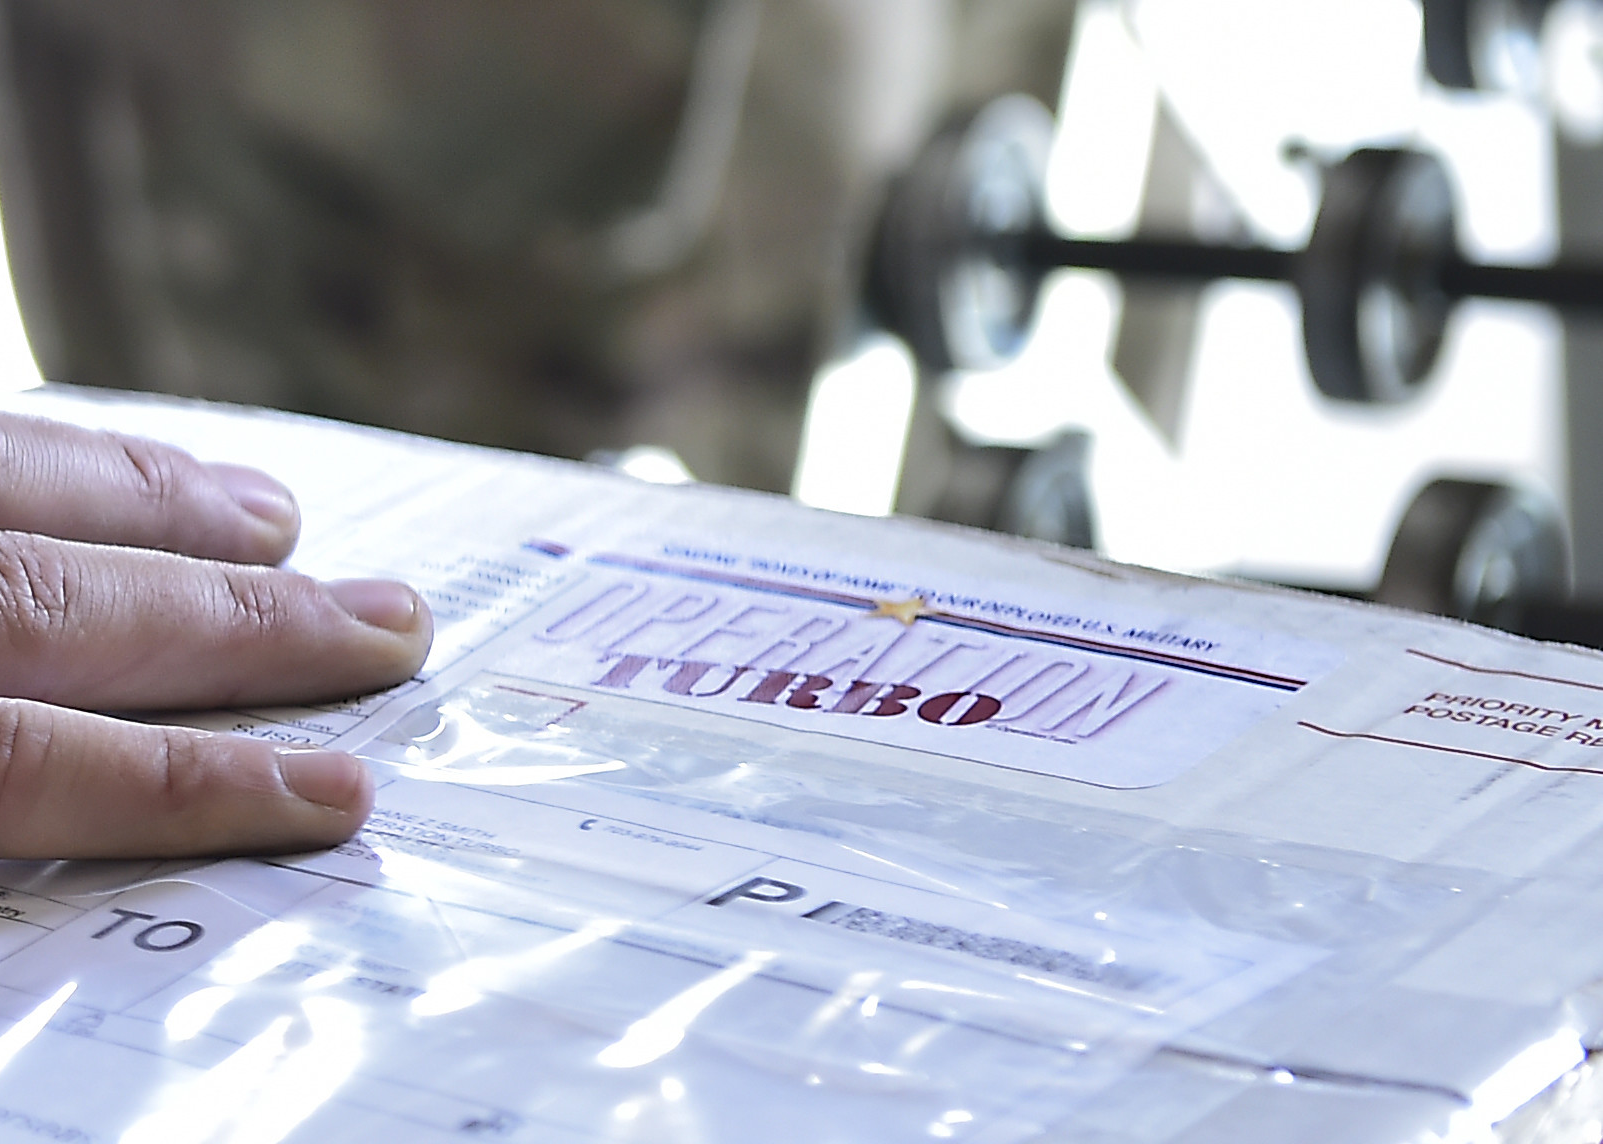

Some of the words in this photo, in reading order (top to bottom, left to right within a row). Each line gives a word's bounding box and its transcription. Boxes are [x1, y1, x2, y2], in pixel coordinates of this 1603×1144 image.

[533, 581, 1170, 739] OPERATION
[590, 653, 1003, 725] TURBO
[1424, 692, 1584, 722] PRIORITY
[1403, 705, 1563, 738] POSTAGE
[365, 816, 458, 844] ERATION
[90, 907, 206, 953] TO
